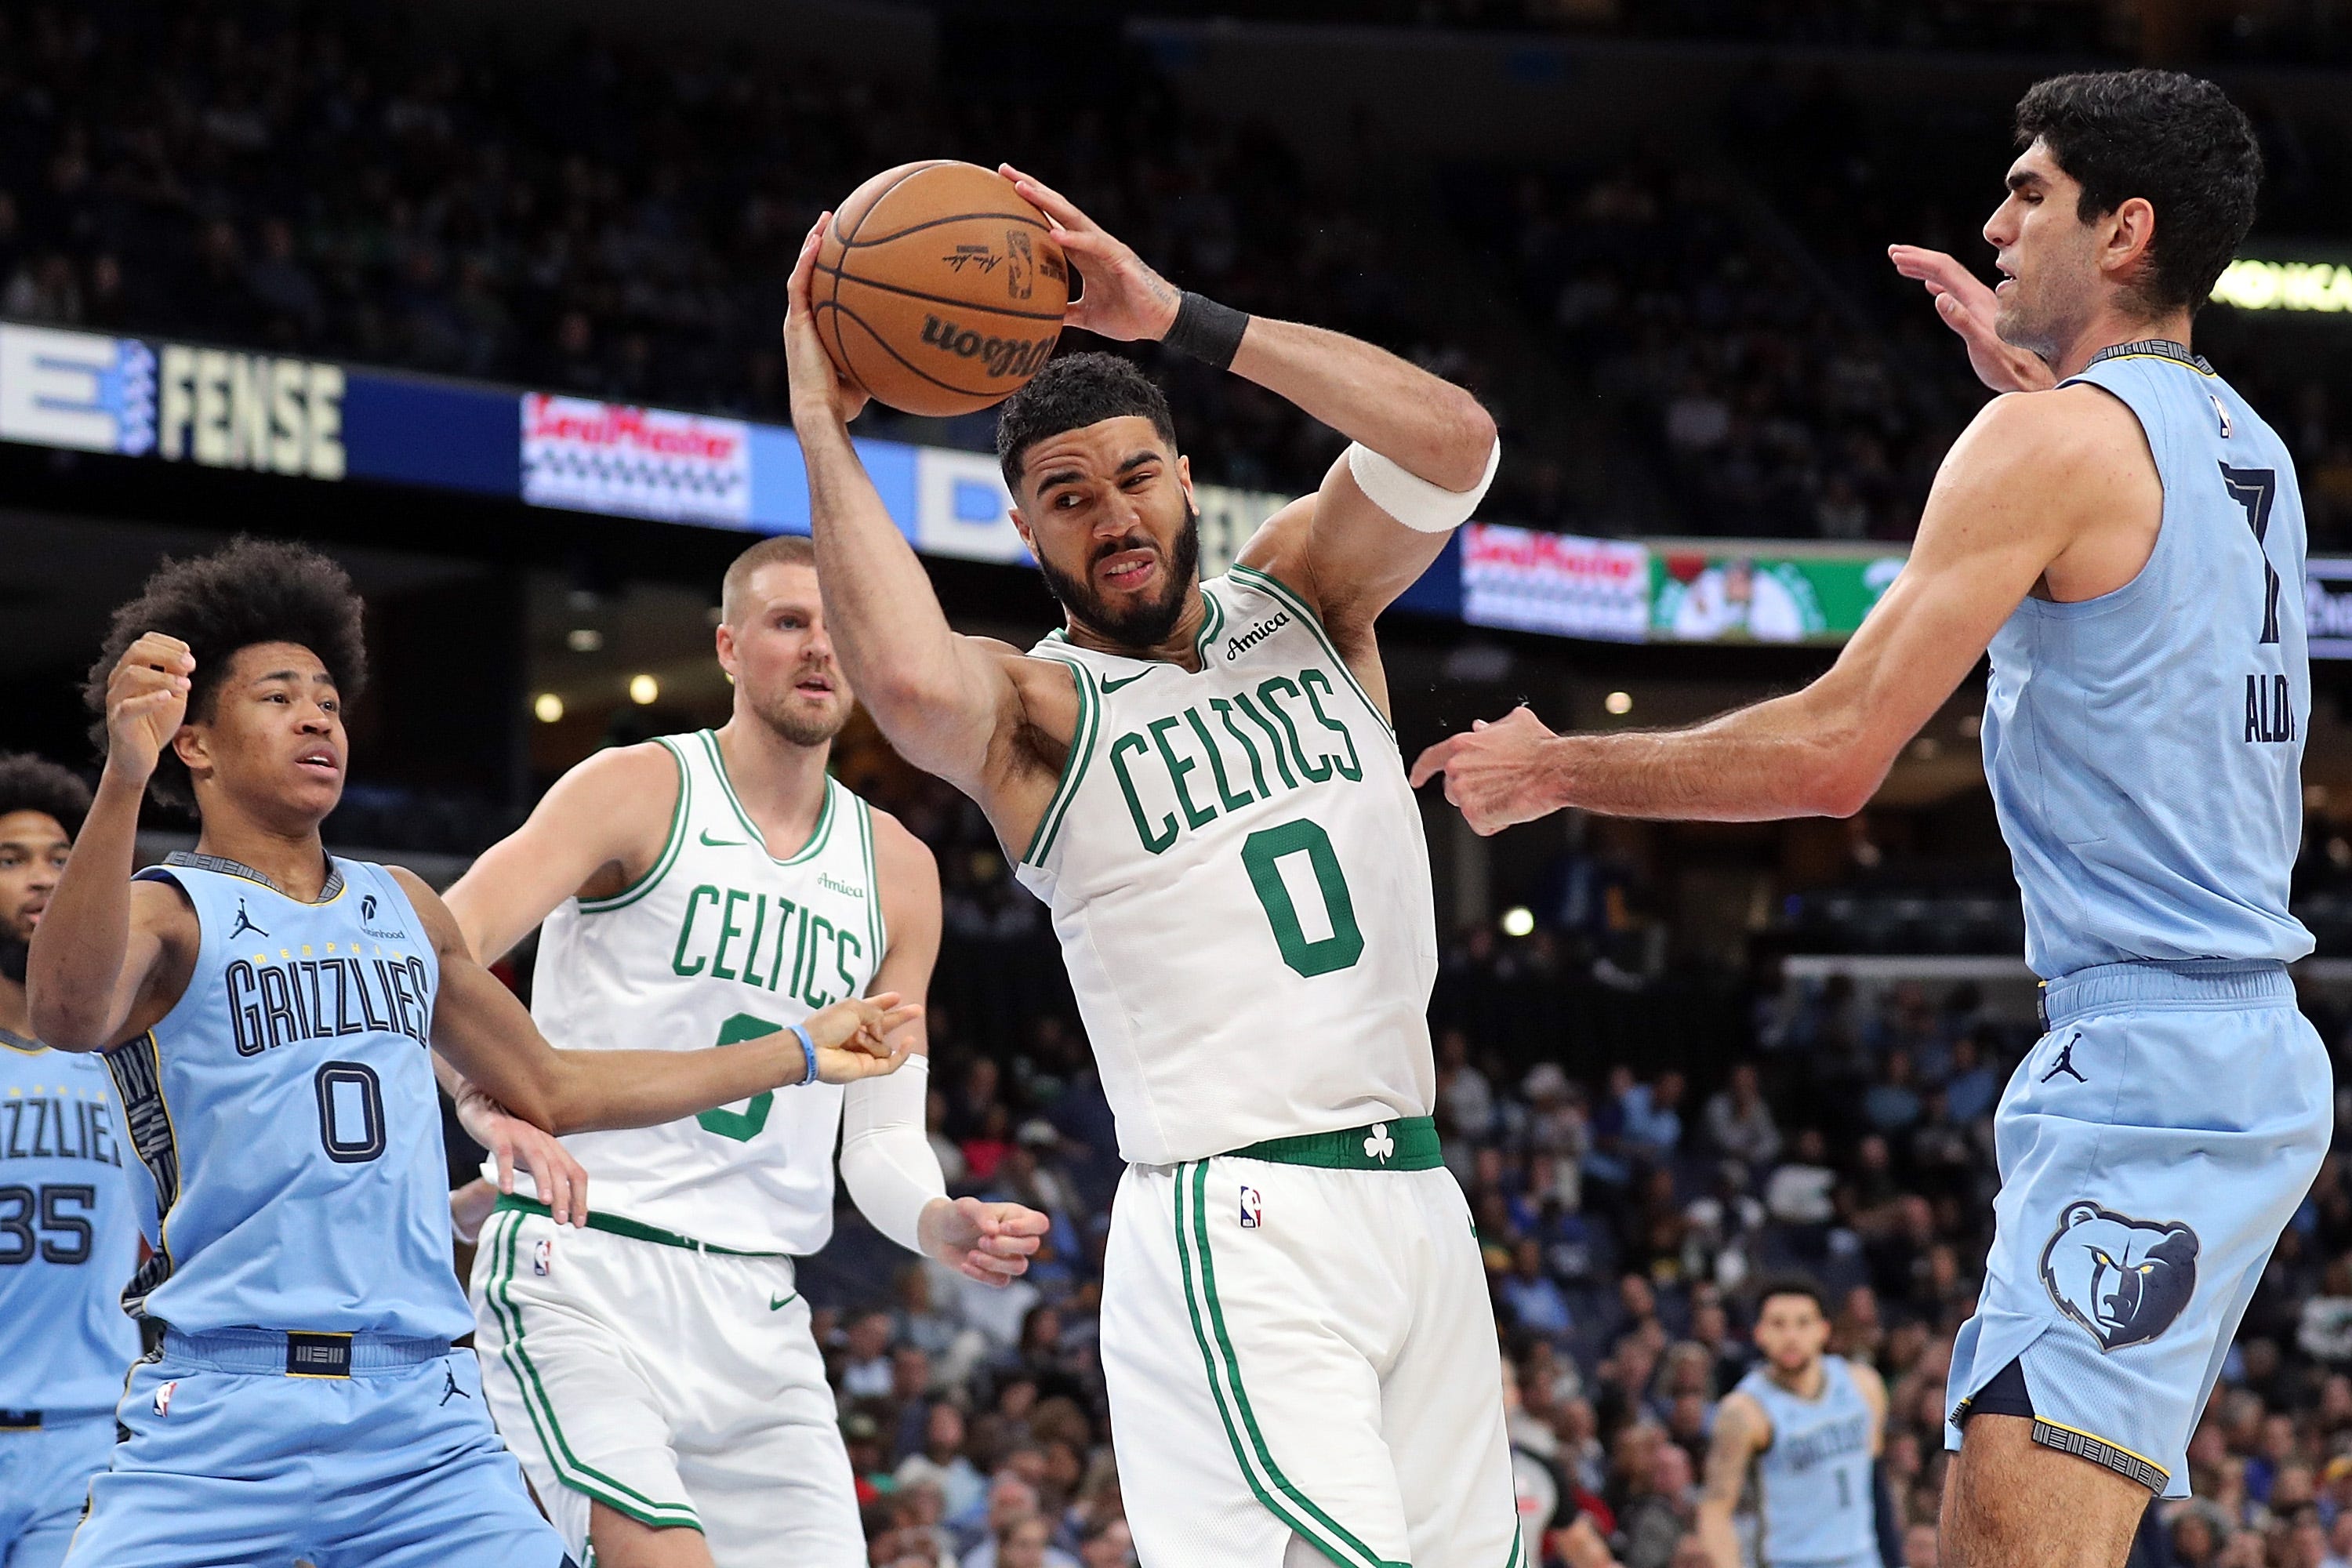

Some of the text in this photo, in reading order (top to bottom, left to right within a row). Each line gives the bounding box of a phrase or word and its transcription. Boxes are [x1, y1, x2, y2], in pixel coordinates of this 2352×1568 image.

[920, 314, 1056, 379] Wilson
[159, 343, 347, 482] FENSE
[2218, 460, 2279, 643] 7
[1226, 611, 1290, 661] Amica
[1109, 669, 1363, 855] CELTICS
[817, 871, 864, 898] Amica
[1240, 818, 1365, 978] 0
[672, 884, 862, 1010] CELTICS
[225, 956, 428, 1058] GRIZZLIES
[0, 1098, 123, 1168] ZZLIE
[314, 1061, 387, 1164] 0
[0, 1183, 96, 1265] 35
